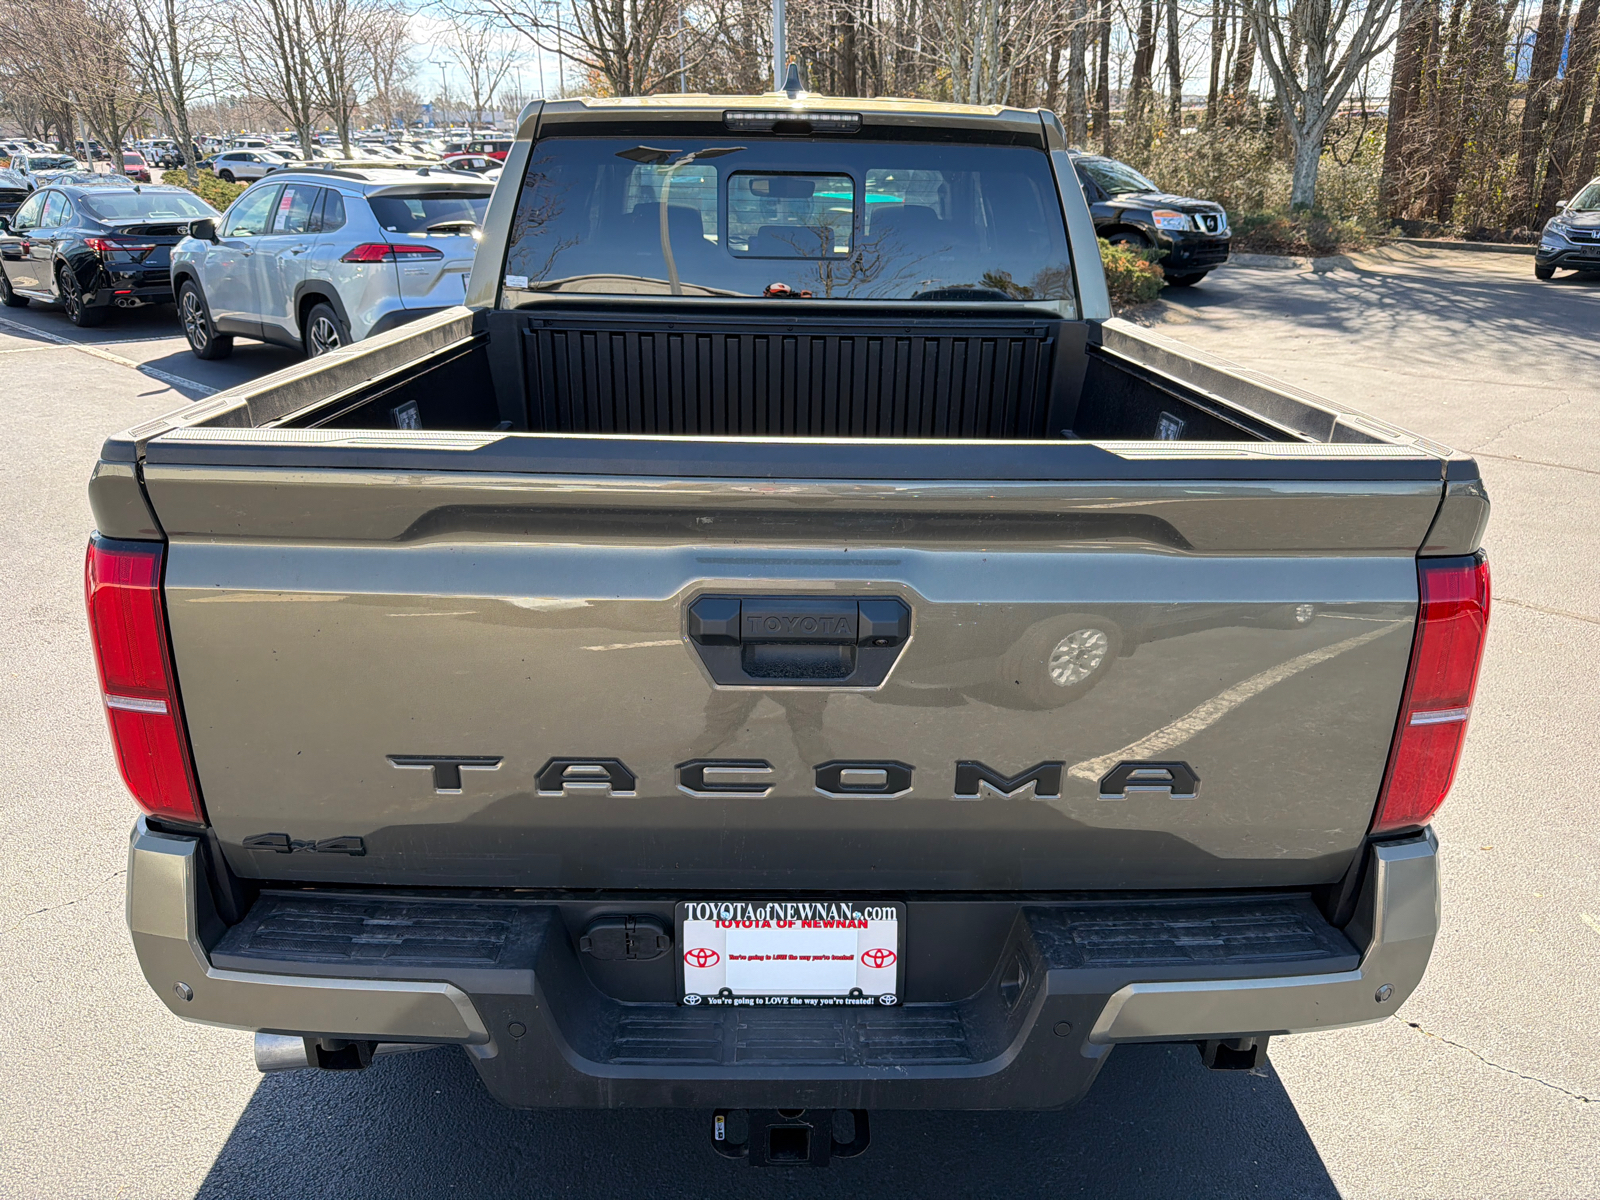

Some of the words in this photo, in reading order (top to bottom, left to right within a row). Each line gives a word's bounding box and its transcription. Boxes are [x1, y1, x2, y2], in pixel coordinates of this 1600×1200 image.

[747, 616, 852, 634] TOYOTA
[386, 754, 1201, 801] TACOMA
[714, 919, 772, 928] TOYOTA
[776, 919, 796, 928] OF
[801, 919, 868, 928] NEWNAN
[734, 997, 754, 1006] going
[765, 997, 789, 1005] LOVE
[791, 997, 802, 1005] the
[820, 998, 844, 1006] you're
